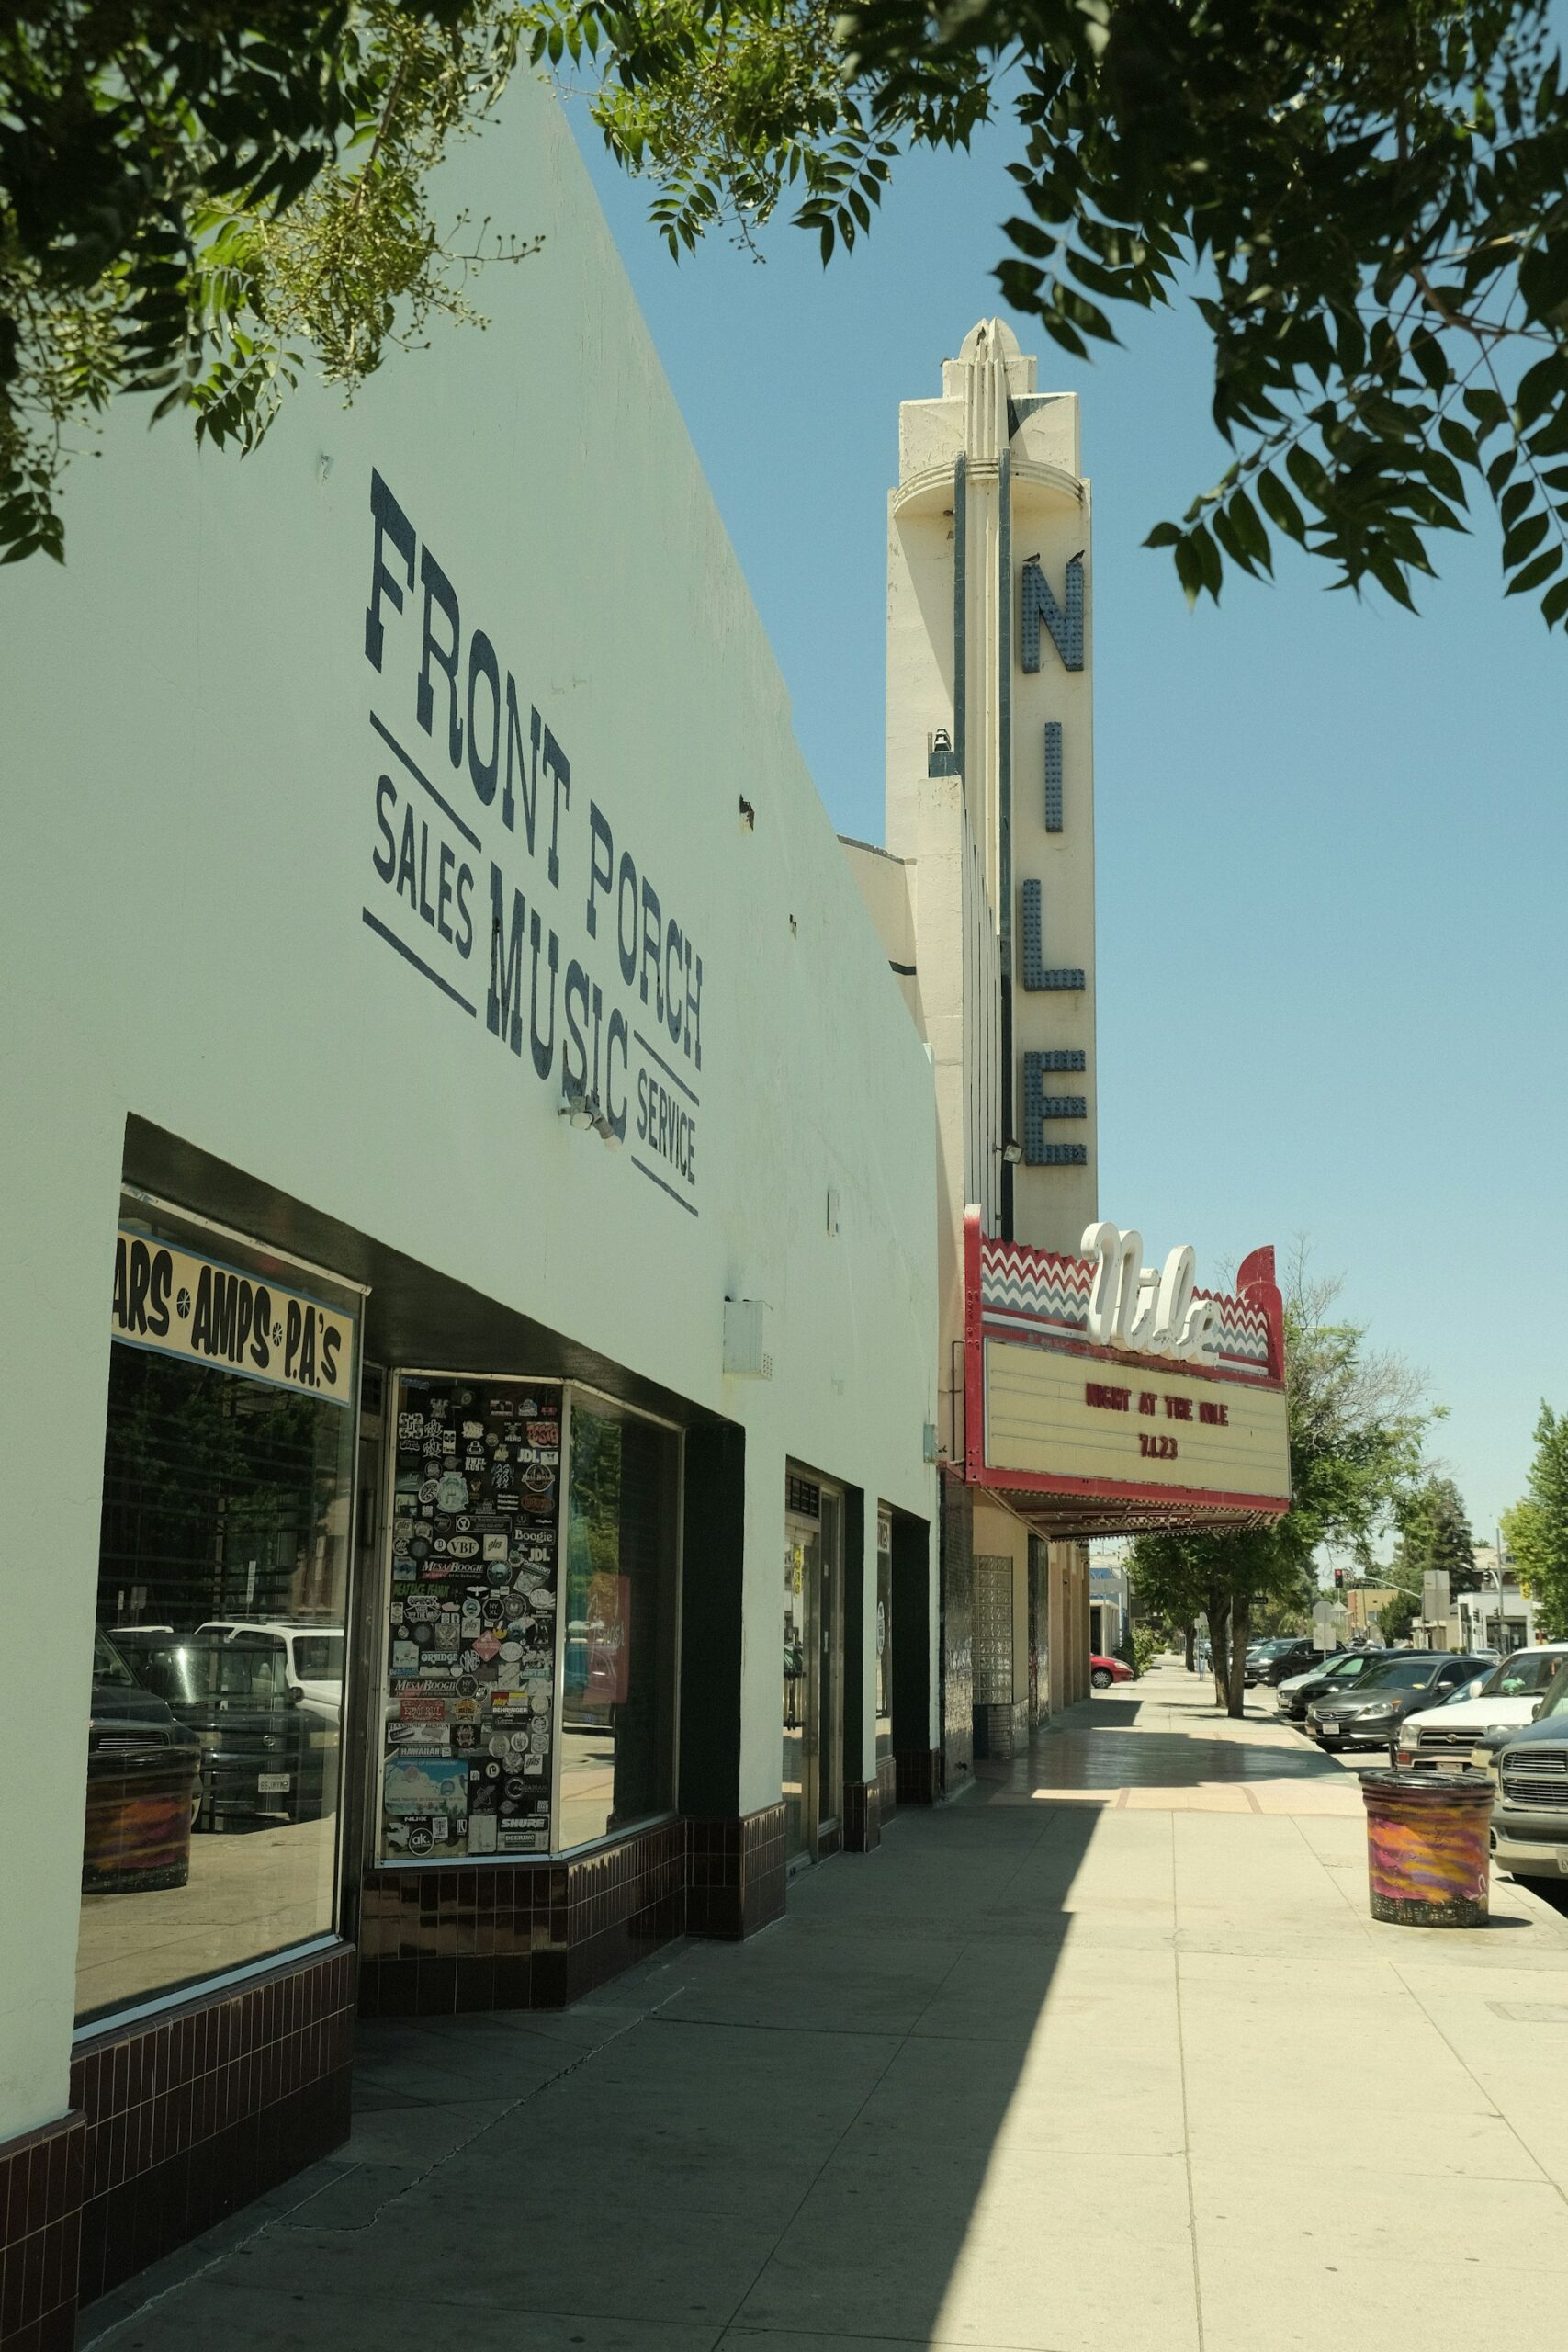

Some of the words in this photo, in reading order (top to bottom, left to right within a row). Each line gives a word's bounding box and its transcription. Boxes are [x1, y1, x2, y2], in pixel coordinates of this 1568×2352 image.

[365, 466, 570, 891] FRONT
[587, 799, 703, 1072] PORCH
[372, 775, 475, 959] SALES
[1021, 562, 1087, 1166] NILE
[487, 860, 628, 1145] MUSIC
[637, 1067, 695, 1186] SERVICE
[191, 1265, 271, 1369] AMPS
[1086, 1383, 1132, 1412] NIGHT
[1139, 1391, 1158, 1416] AT
[1165, 1395, 1193, 1421] THE
[1199, 1401, 1229, 1426] NILE
[450, 1542, 477, 1553] VBF
[514, 1529, 553, 1544] Boogie
[400, 1747, 440, 1756] HAWAIIAN
[500, 1818, 546, 1828] SHURE
